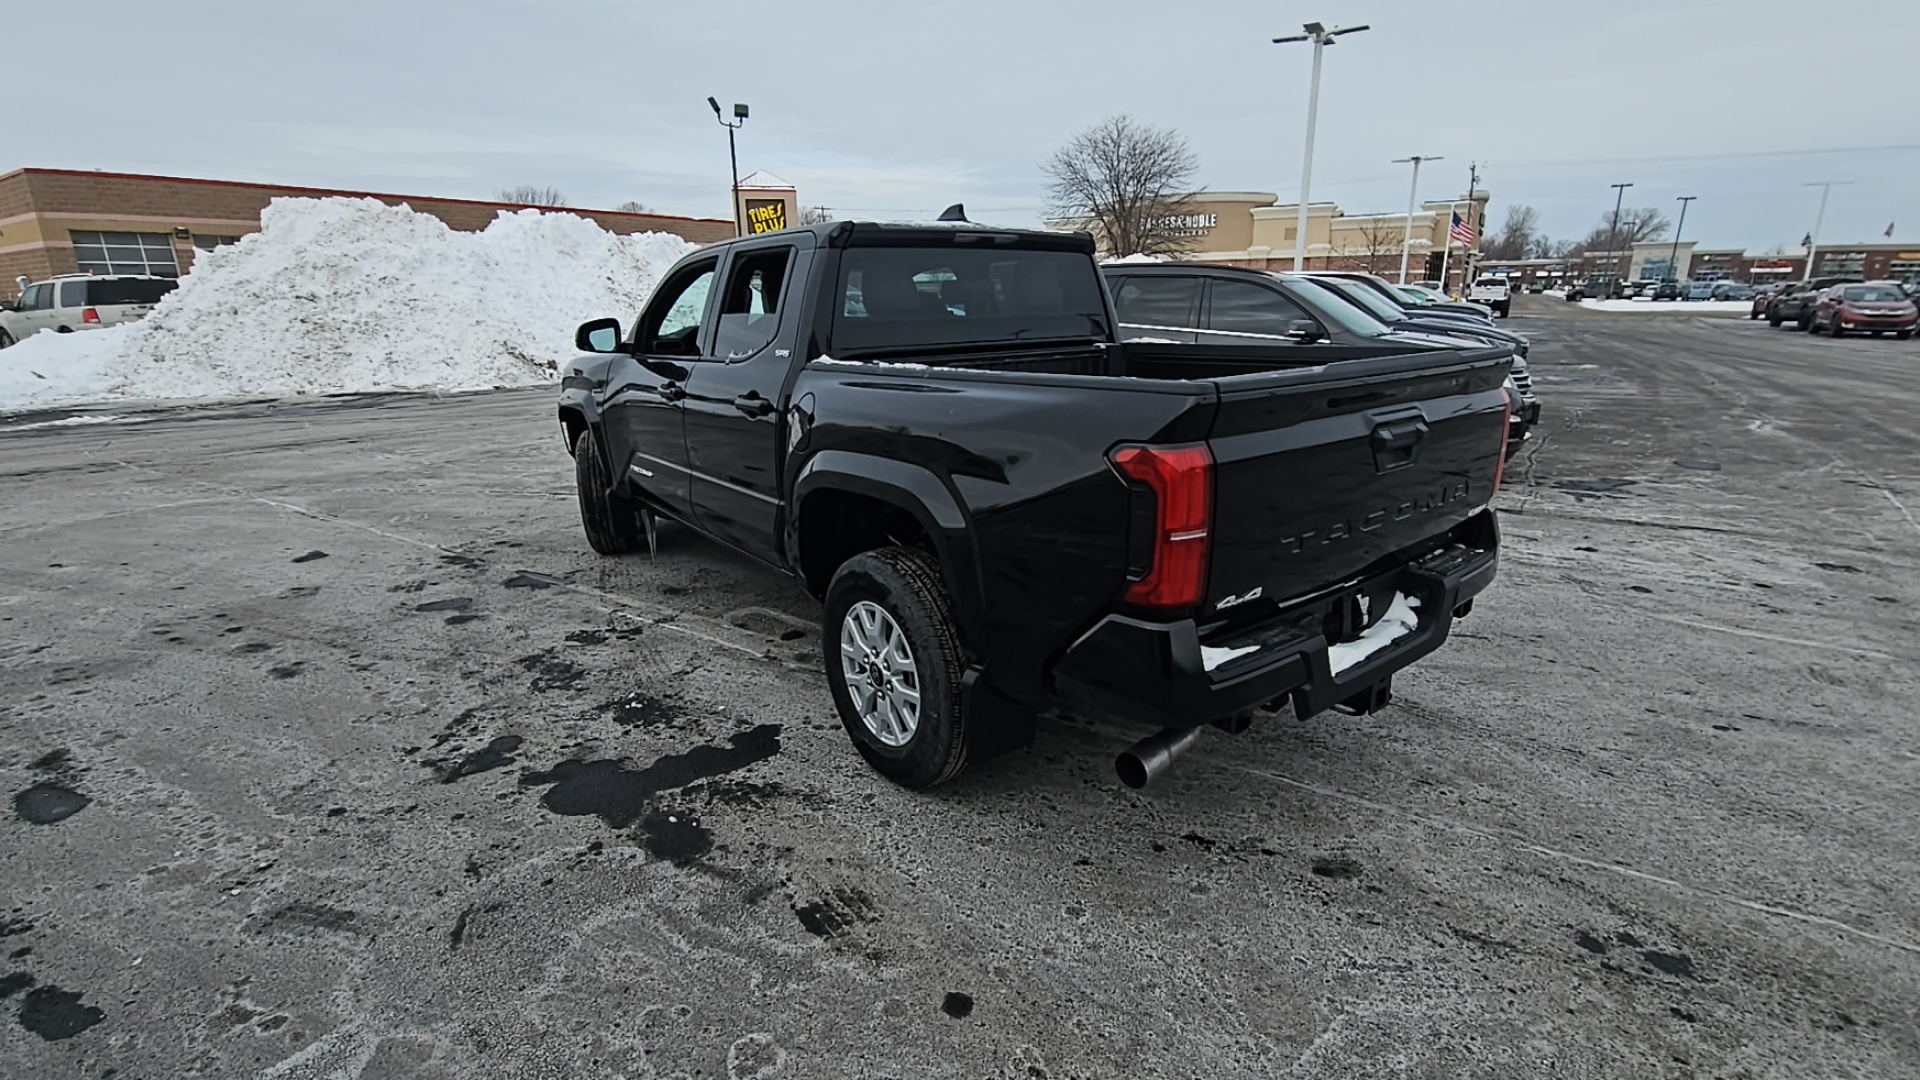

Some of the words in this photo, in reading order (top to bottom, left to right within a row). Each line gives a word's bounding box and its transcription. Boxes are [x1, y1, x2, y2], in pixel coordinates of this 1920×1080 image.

[748, 203, 783, 223] TIRES
[754, 216, 785, 235] PLUS
[774, 347, 791, 358] SR5
[1280, 479, 1469, 555] TACOMA
